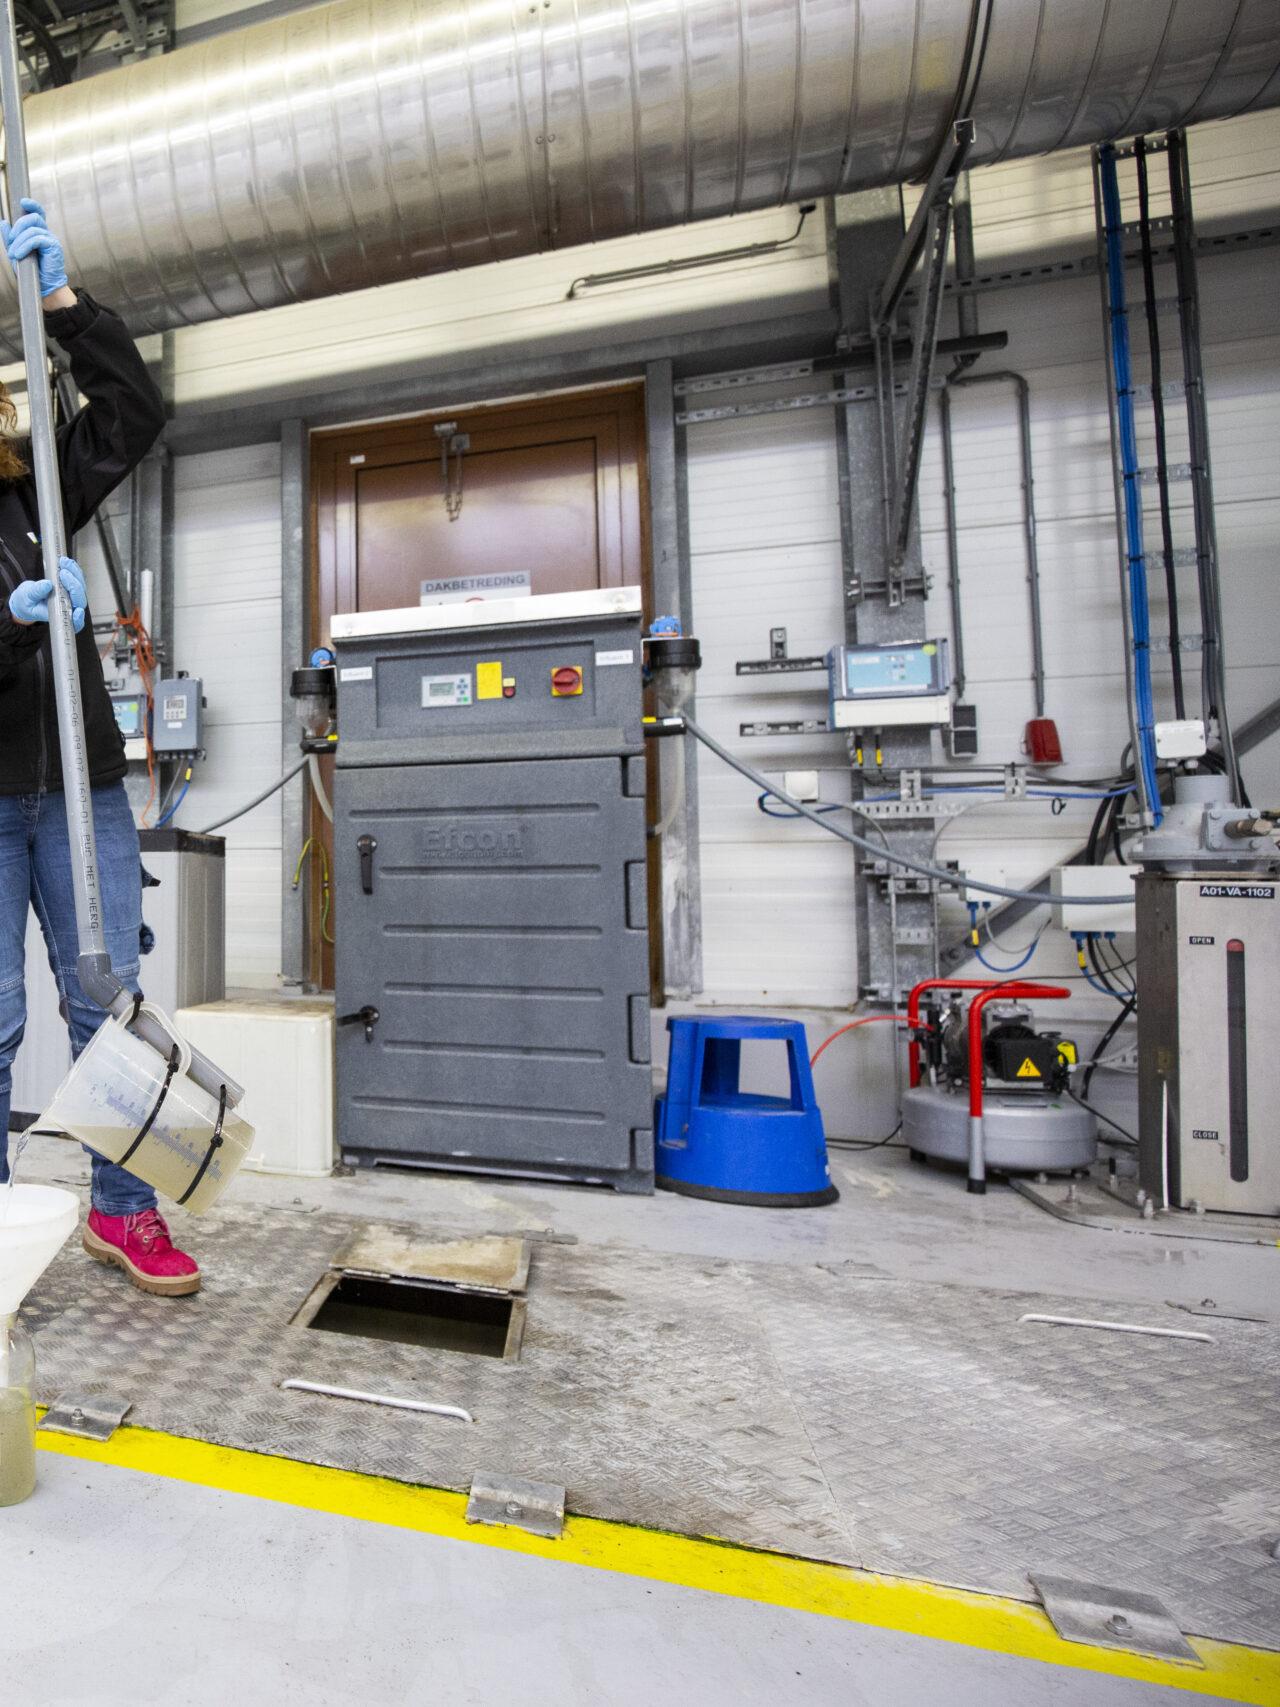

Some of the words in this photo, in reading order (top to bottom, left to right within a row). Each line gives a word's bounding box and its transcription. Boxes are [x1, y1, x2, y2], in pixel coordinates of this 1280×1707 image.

[425, 574, 525, 592] DAKBETREDING
[86, 865, 96, 888] MET
[1201, 886, 1272, 897] A01-VA-1102
[1193, 1131, 1217, 1139] CLOSE
